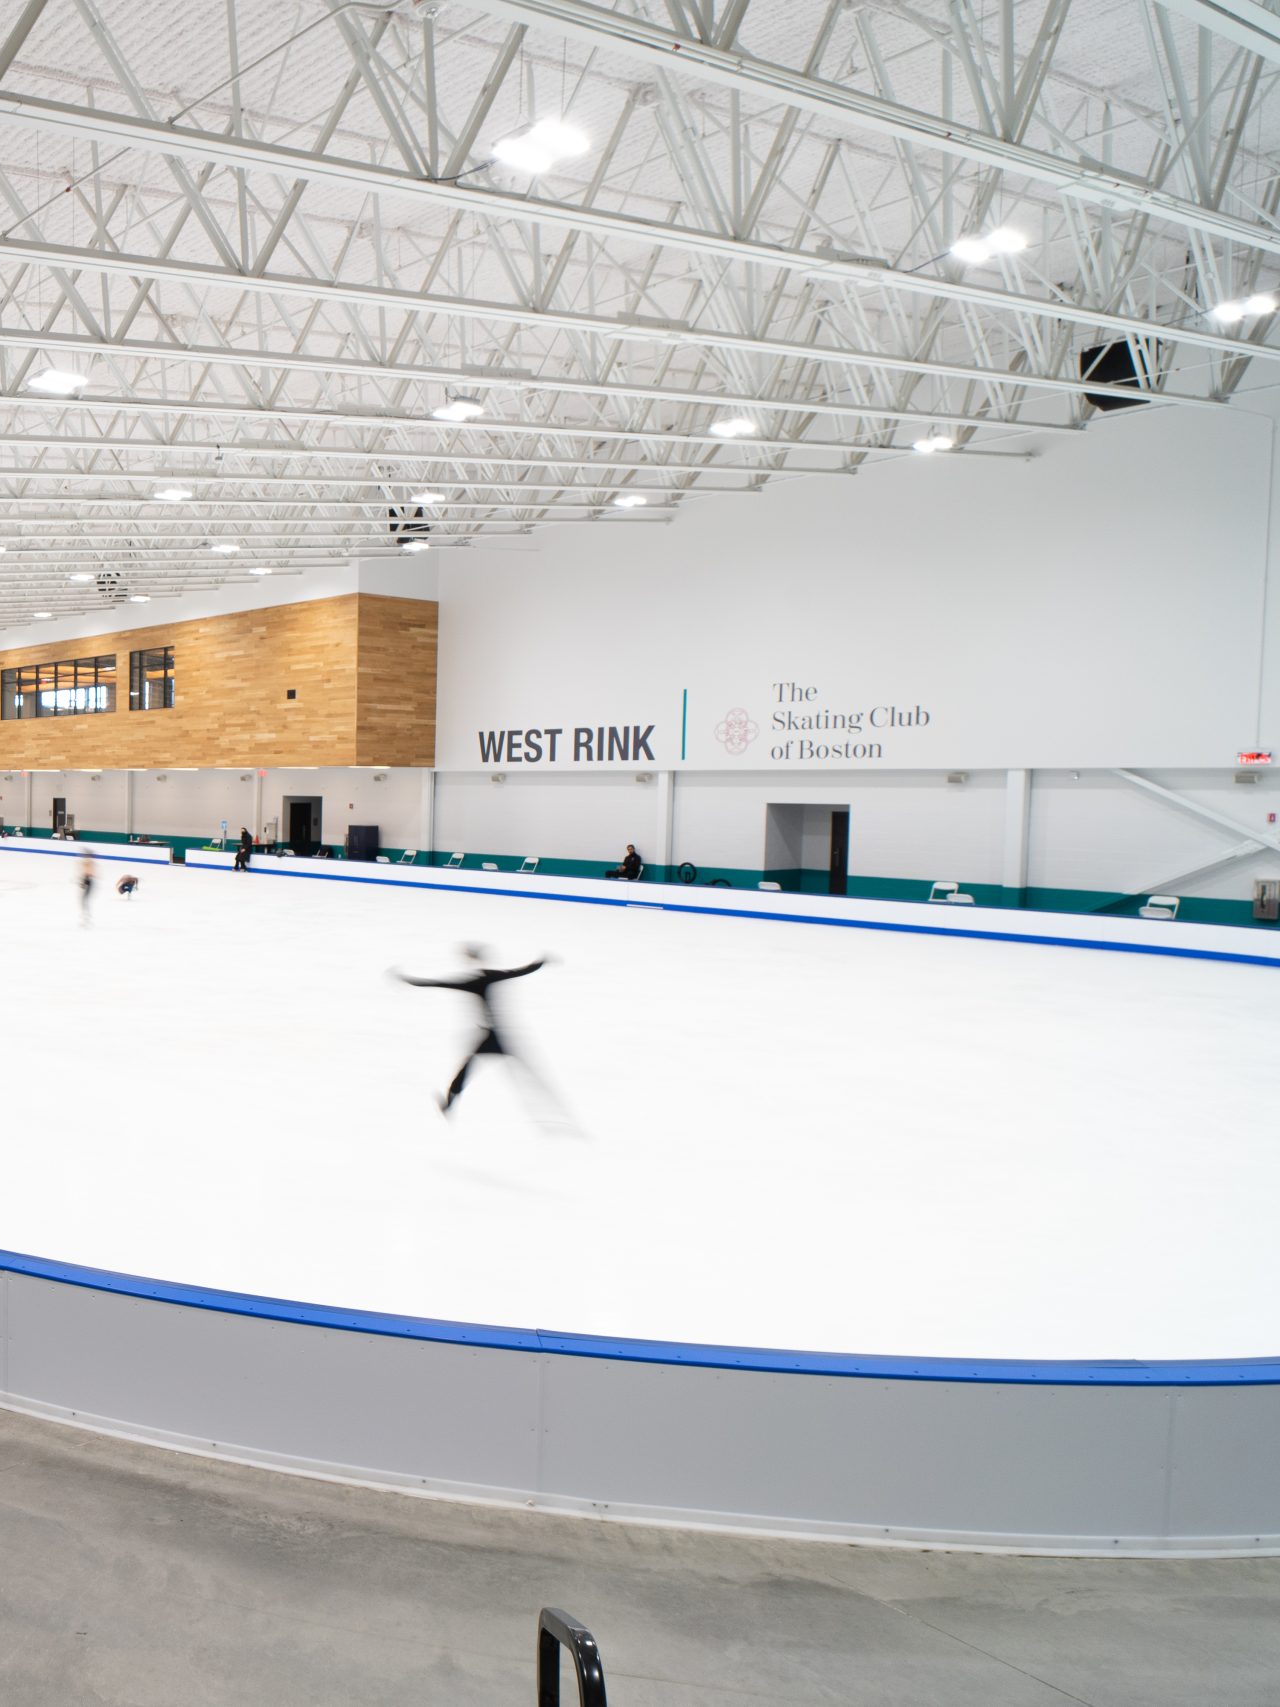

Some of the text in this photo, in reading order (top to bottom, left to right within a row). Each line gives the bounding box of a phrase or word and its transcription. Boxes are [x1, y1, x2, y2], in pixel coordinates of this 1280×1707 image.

[772, 681, 818, 703] The
[771, 705, 931, 734] Skating Club
[478, 725, 656, 763] WEST RINK
[770, 739, 883, 760] of Boston
